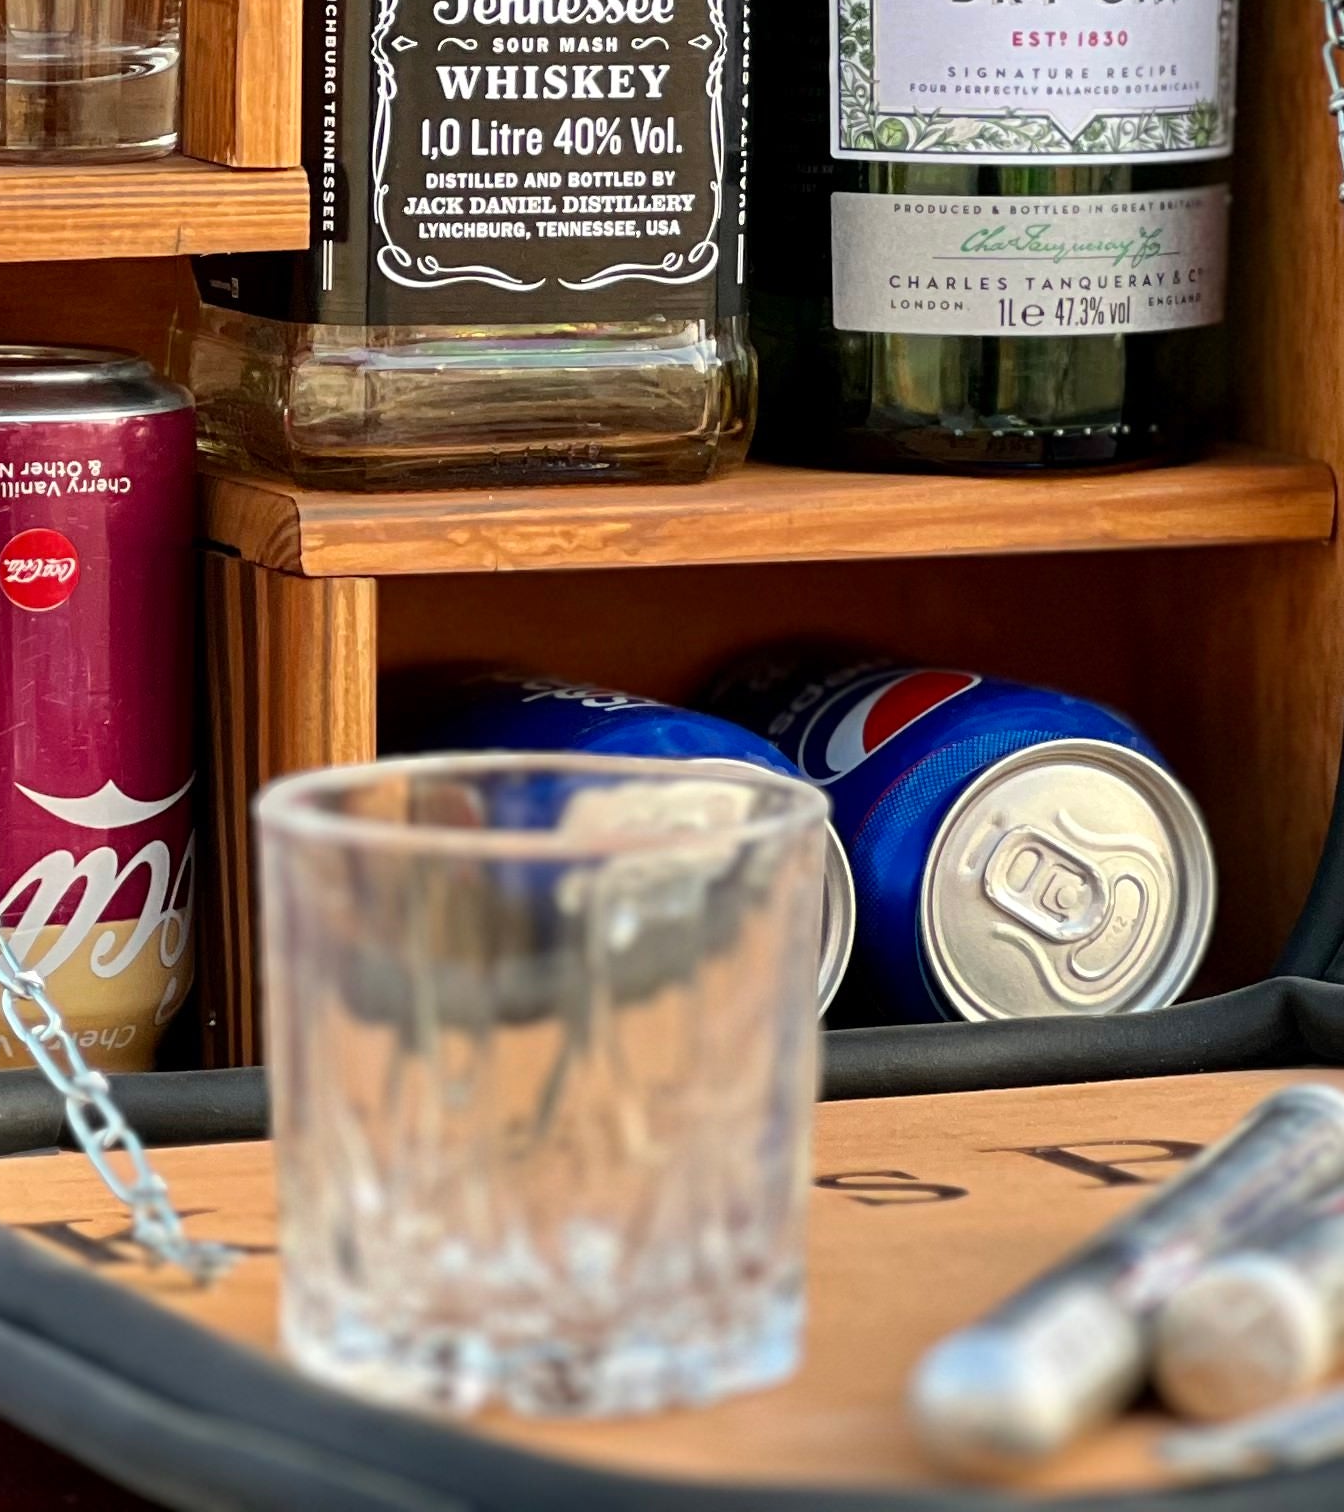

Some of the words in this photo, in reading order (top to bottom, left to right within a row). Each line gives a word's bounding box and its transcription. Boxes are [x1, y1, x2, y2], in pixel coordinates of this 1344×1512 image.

[492, 37, 549, 53] SOUR
[560, 36, 619, 52] MASH
[1077, 30, 1129, 47] 1830
[947, 66, 1089, 79] SIGNATURE
[1106, 64, 1178, 79] RECIPE
[436, 64, 670, 100] WHISKEY
[909, 82, 947, 93] FOUR
[954, 85, 1039, 95] PERFECTLY
[1046, 85, 1119, 96] BALANCED
[471, 118, 543, 156] Litre
[553, 117, 621, 155] 40%
[631, 117, 683, 155] Vol.
[323, 101, 335, 232] TENNESSEE
[737, 116, 748, 226] QUALITY
[425, 172, 518, 189] DISTILLED
[524, 172, 561, 188] AND
[568, 171, 645, 188] BOTTLED
[652, 170, 675, 186] BY
[403, 196, 463, 216] JACK
[469, 195, 556, 215] DANIEL
[562, 194, 695, 214] DISTILLERY
[894, 203, 983, 215] PRODUCED
[991, 205, 1000, 215] &
[1009, 205, 1080, 215] BOTTLED
[1088, 204, 1103, 214] IN
[1111, 202, 1154, 213] GREAT
[419, 221, 530, 240] LYNCHBURG,
[536, 220, 641, 239] TENNESSEE,
[646, 219, 681, 237] USA
[888, 274, 1008, 291] CHARLES
[1024, 272, 1166, 291] TANQUERAY
[1171, 270, 1181, 285] &
[890, 298, 964, 311] LONDON
[1148, 292, 1202, 308] ENGLAND
[1054, 296, 1105, 327] 47.3%
[1109, 295, 1130, 325] vol
[20, 459, 83, 479] Other
[88, 459, 102, 477] &
[66, 476, 131, 495] Cherry
